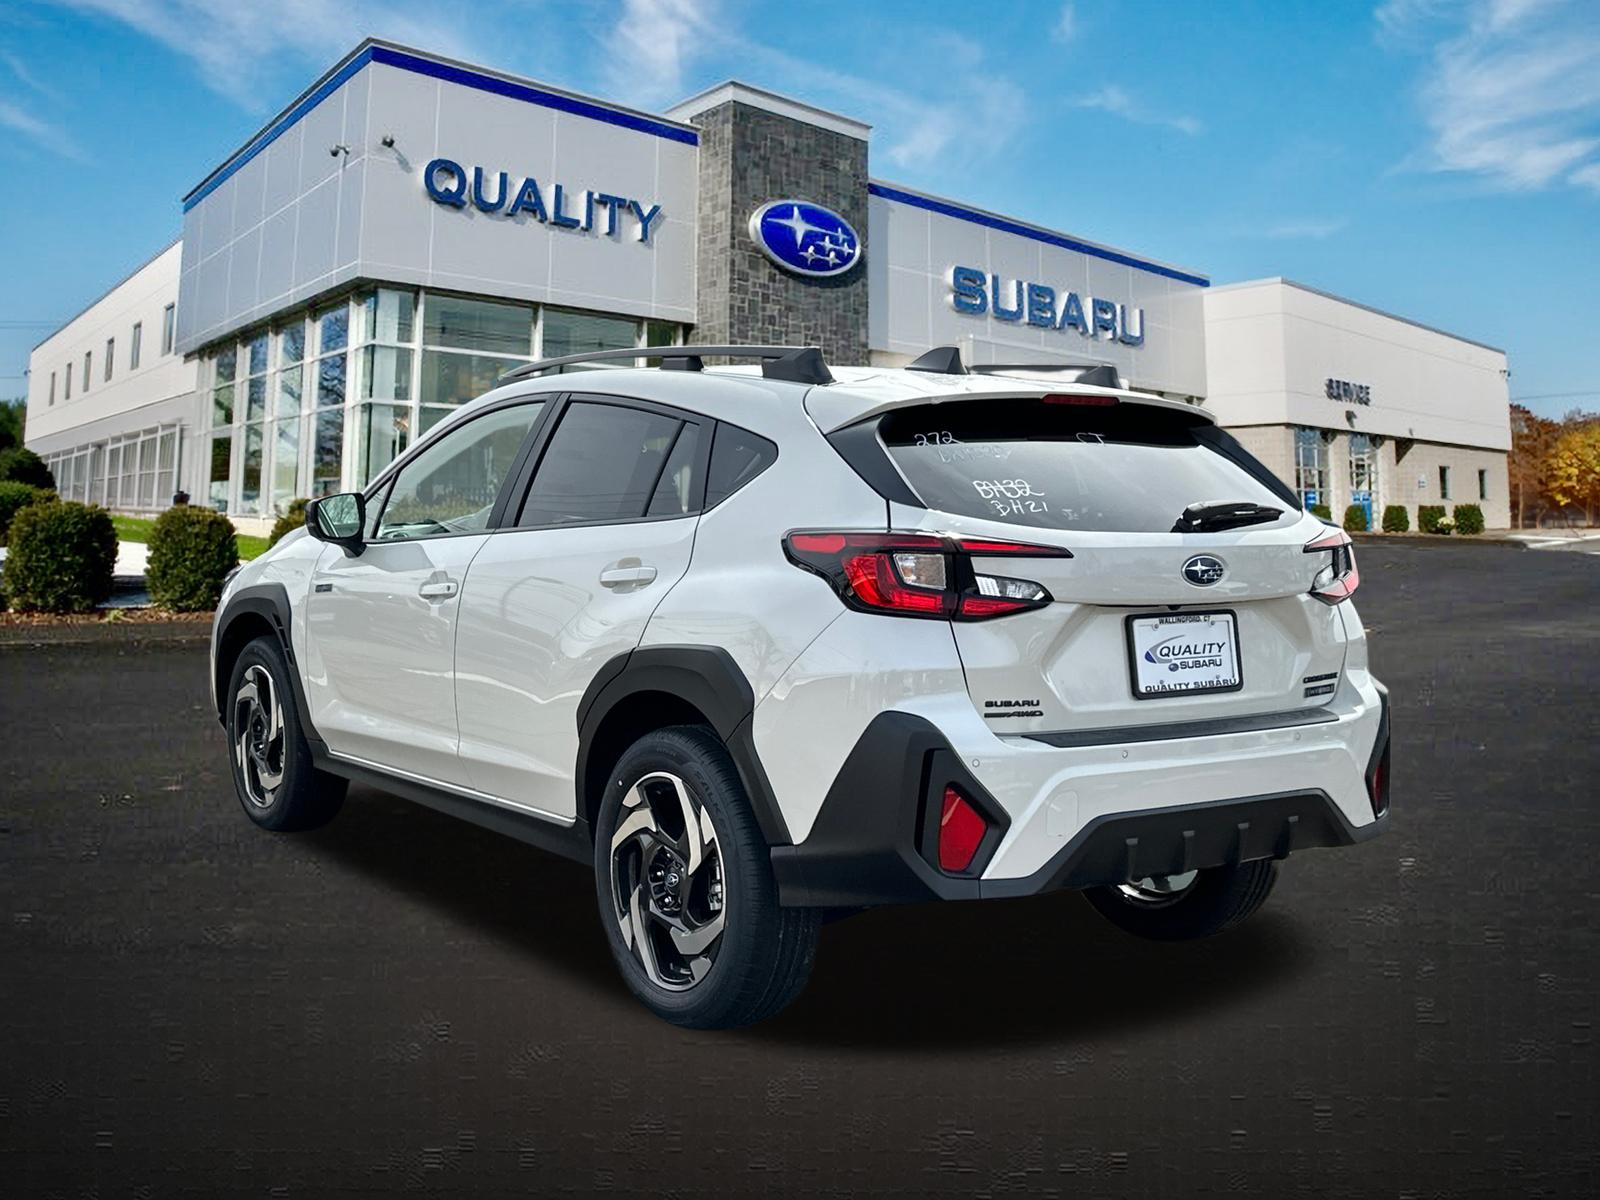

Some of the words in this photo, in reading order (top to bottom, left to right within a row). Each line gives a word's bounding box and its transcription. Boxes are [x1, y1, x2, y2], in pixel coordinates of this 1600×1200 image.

[423, 157, 662, 243] QUALITY
[949, 265, 1145, 347] SUBARU
[914, 431, 967, 447] 272
[1159, 641, 1226, 658] QUALITY
[1179, 658, 1222, 670] SUBARU
[1145, 682, 1190, 693] QUALITY
[1193, 678, 1237, 689] SUBARU
[984, 699, 1040, 708] SUBARU
